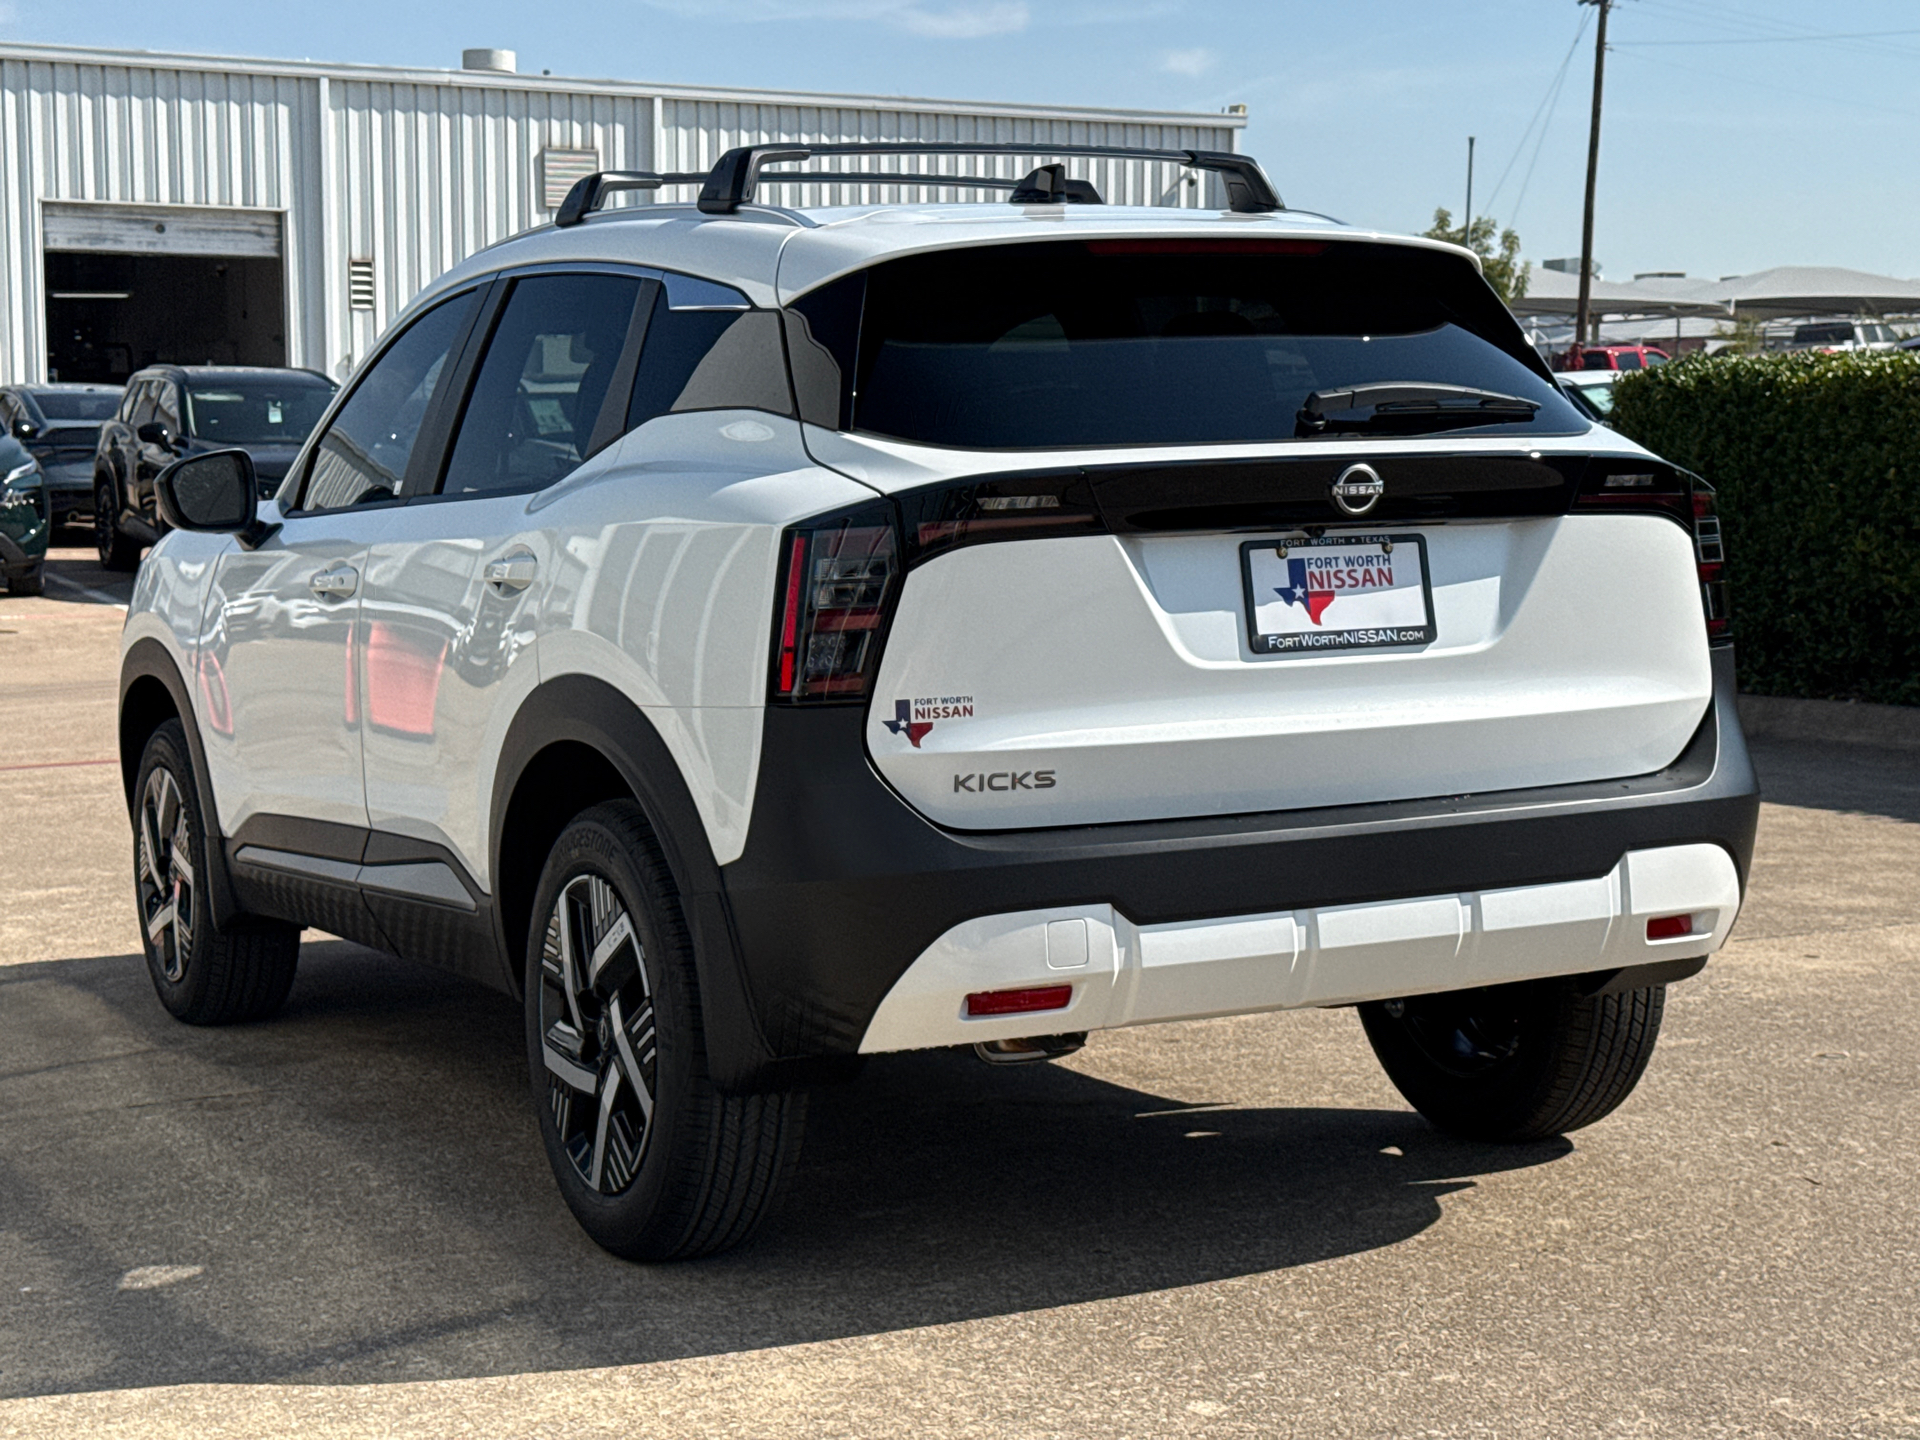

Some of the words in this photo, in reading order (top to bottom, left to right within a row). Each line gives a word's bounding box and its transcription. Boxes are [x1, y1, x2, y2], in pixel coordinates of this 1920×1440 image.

[1333, 483, 1384, 497] NISSAN
[1280, 539, 1305, 548] FORT
[1310, 537, 1345, 546] WORTH
[1361, 535, 1391, 544] TEXAS
[1307, 557, 1340, 569] FORT
[1345, 554, 1391, 567] WORTH
[1308, 567, 1394, 590] NISSAN
[914, 698, 939, 706] FORT
[940, 696, 973, 704] WORTH
[914, 705, 974, 720] NISSAN
[953, 769, 1057, 793] KICKS
